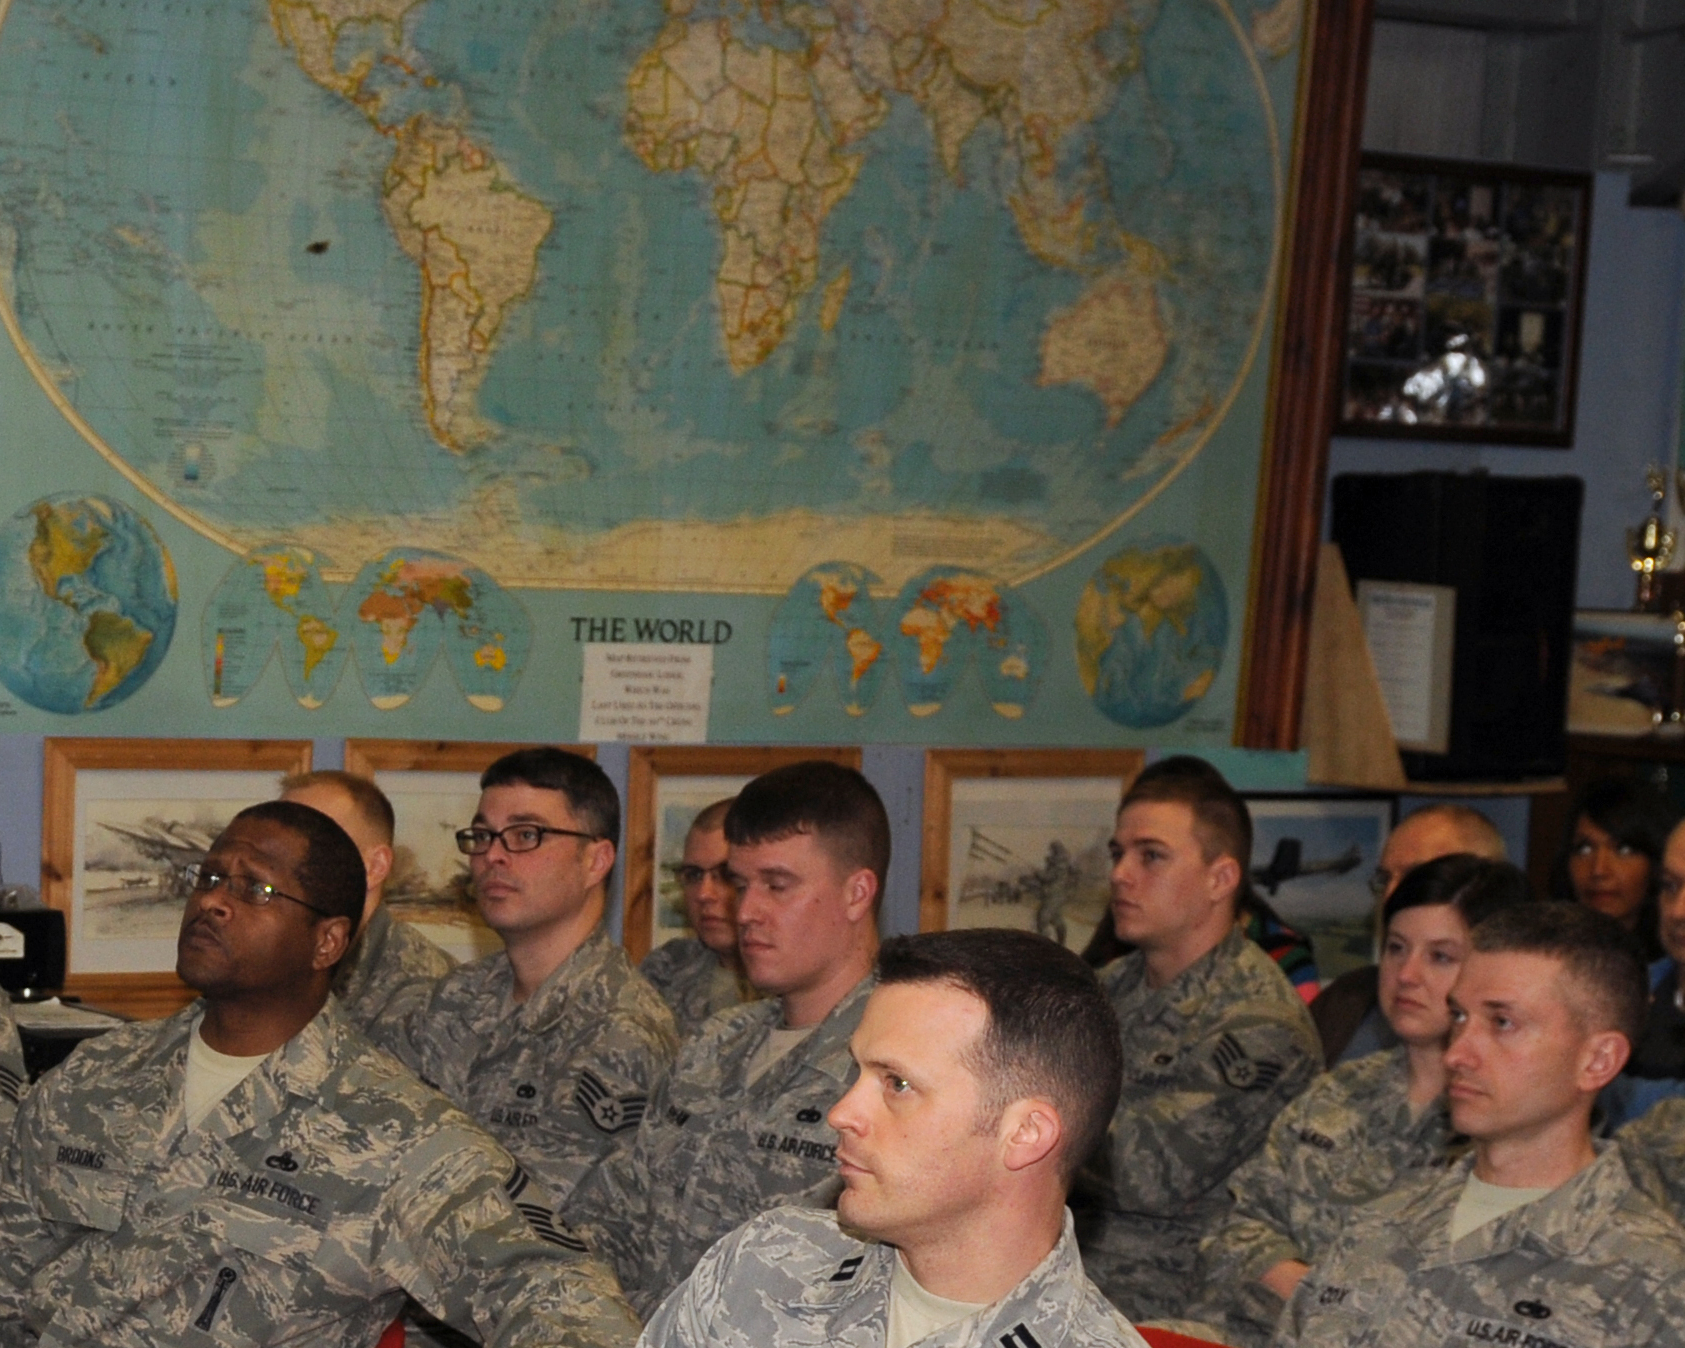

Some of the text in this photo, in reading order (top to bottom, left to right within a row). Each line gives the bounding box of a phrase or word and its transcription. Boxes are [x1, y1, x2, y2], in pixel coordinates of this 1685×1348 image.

[570, 617, 733, 645] THE WORLD
[56, 1145, 106, 1169] BROOKS
[778, 1136, 798, 1154] AIR
[798, 1140, 838, 1163] FORCE
[217, 1170, 321, 1215] U.S. AIR FORCE
[1466, 1319, 1489, 1339] U.S.
[1490, 1325, 1520, 1347] AIR
